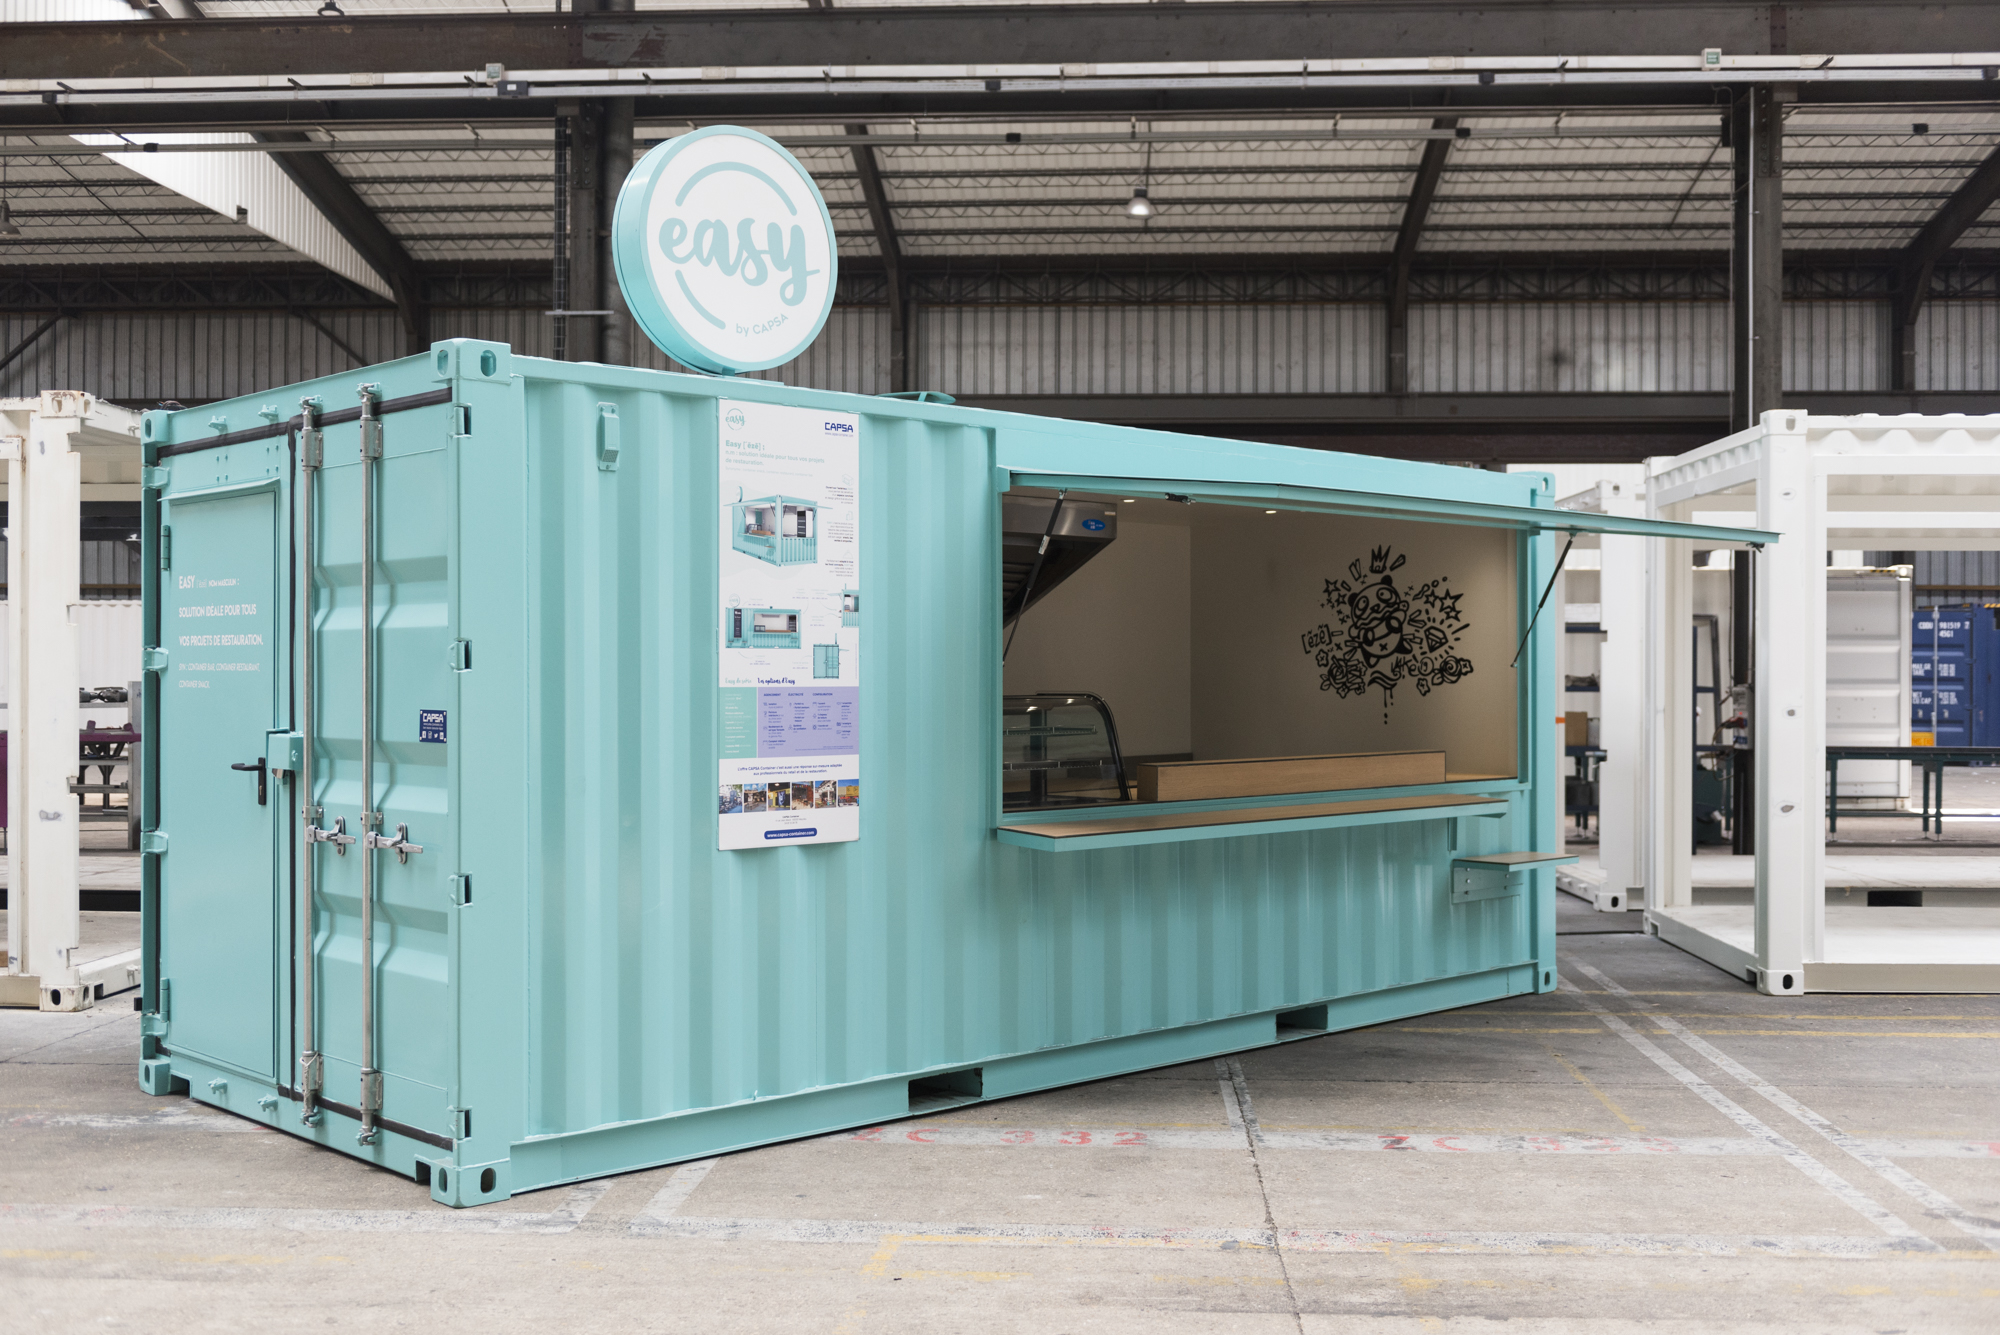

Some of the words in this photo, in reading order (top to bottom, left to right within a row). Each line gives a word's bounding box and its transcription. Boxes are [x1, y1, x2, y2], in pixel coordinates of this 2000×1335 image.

[659, 217, 820, 306] easy
[736, 323, 749, 337] by
[752, 313, 789, 335] CAPSA
[725, 415, 746, 426] easy
[825, 422, 854, 433] CAPSA
[725, 440, 742, 450] Easy
[179, 575, 195, 589] EASY
[179, 606, 205, 617] SOLUTION
[224, 604, 241, 616] POUR
[241, 603, 257, 615] TOUS
[179, 635, 190, 646] VOS
[190, 635, 212, 646] PROJETS
[213, 635, 221, 646] DE
[221, 634, 264, 646] RESTAURATION.
[422, 713, 444, 723] CAPSA
